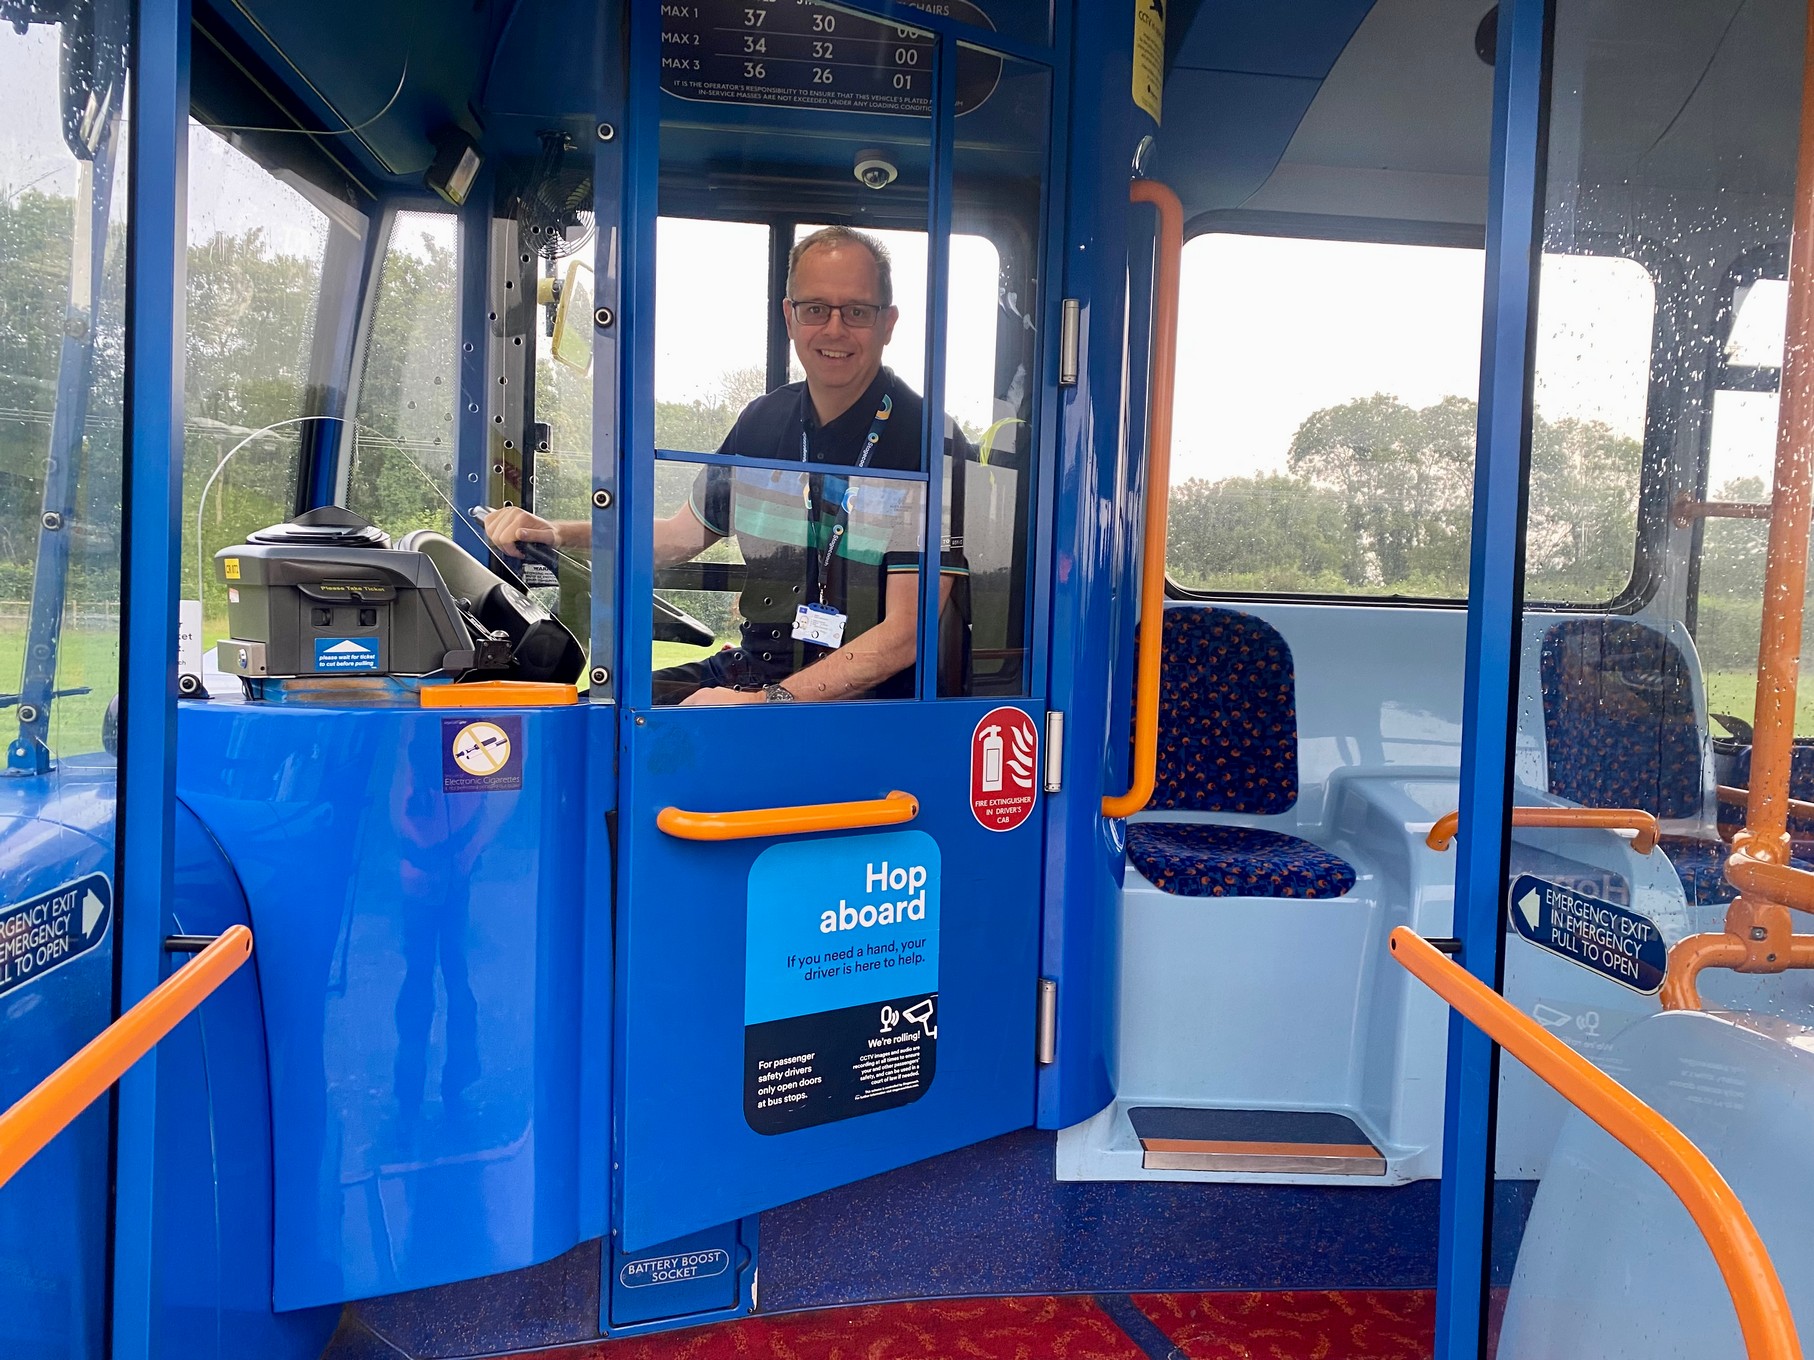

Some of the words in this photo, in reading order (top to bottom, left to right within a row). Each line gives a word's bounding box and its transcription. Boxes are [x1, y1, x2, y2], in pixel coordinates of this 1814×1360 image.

[661, 5, 689, 17] MAX
[694, 8, 698, 18] 1
[744, 9, 766, 27] 37
[812, 14, 836, 33] 30
[661, 32, 689, 45] MAX
[693, 35, 700, 45] 2
[743, 36, 767, 53] 34
[812, 42, 833, 59] 32
[895, 48, 918, 65] 00
[662, 57, 690, 69] MAX
[693, 59, 700, 70] 3
[744, 62, 766, 78] 36
[812, 68, 833, 84] 26
[892, 74, 912, 89] 01
[698, 90, 735, 98] IN-SERVICE
[736, 91, 762, 99] MASSES
[793, 95, 828, 104] EXCEEDED
[869, 101, 899, 109] LOADING
[703, 82, 745, 91] OPERATOR'S
[746, 86, 797, 95] RESPONSIBILITY
[809, 90, 836, 98] ENSURE
[859, 442, 873, 467] Stagecoa
[444, 777, 482, 786] Electronic
[483, 776, 520, 785] Cigarettes
[975, 799, 988, 808] FIRE
[989, 796, 1032, 807] EXTINGUISHER
[995, 806, 1022, 815] DRIVER'S
[866, 861, 927, 895] Hop
[52, 890, 77, 917] EXIT
[820, 890, 926, 933] aboard
[1546, 889, 1618, 929] EMERGENCY
[1621, 917, 1651, 942] EXIT
[1551, 909, 1563, 928] IN
[1566, 917, 1642, 960] EMERGENCY
[15, 953, 33, 976] TO
[36, 935, 69, 966] OPEN
[787, 954, 796, 968] If
[798, 956, 821, 969] you
[824, 946, 854, 962] need
[857, 948, 863, 957] a
[866, 940, 899, 956] hand,
[901, 938, 927, 953] your
[1551, 929, 1578, 954] PULL
[1582, 941, 1599, 961] TO
[1602, 950, 1639, 980] OPEN
[804, 966, 841, 981] driver
[843, 963, 852, 975] is
[855, 961, 881, 972] here
[883, 957, 895, 968] to
[898, 952, 925, 966] help.
[868, 1037, 892, 1049] We're
[893, 1030, 921, 1044] rolling!
[758, 1060, 772, 1070] For
[773, 1052, 816, 1069] passenger
[852, 1061, 875, 1070] recording
[860, 1054, 874, 1062] CCTV
[758, 1071, 784, 1083] safety
[784, 1066, 812, 1077] drivers
[900, 1065, 911, 1073] used
[757, 1085, 776, 1095] only
[777, 1081, 798, 1092] open
[799, 1076, 822, 1087] doors
[757, 1099, 766, 1108] at
[767, 1097, 782, 1107] bus
[784, 1092, 808, 1102] stops.
[628, 1258, 678, 1275] BATTERY
[682, 1252, 721, 1266] BOOST
[652, 1266, 698, 1282] SOCKET
